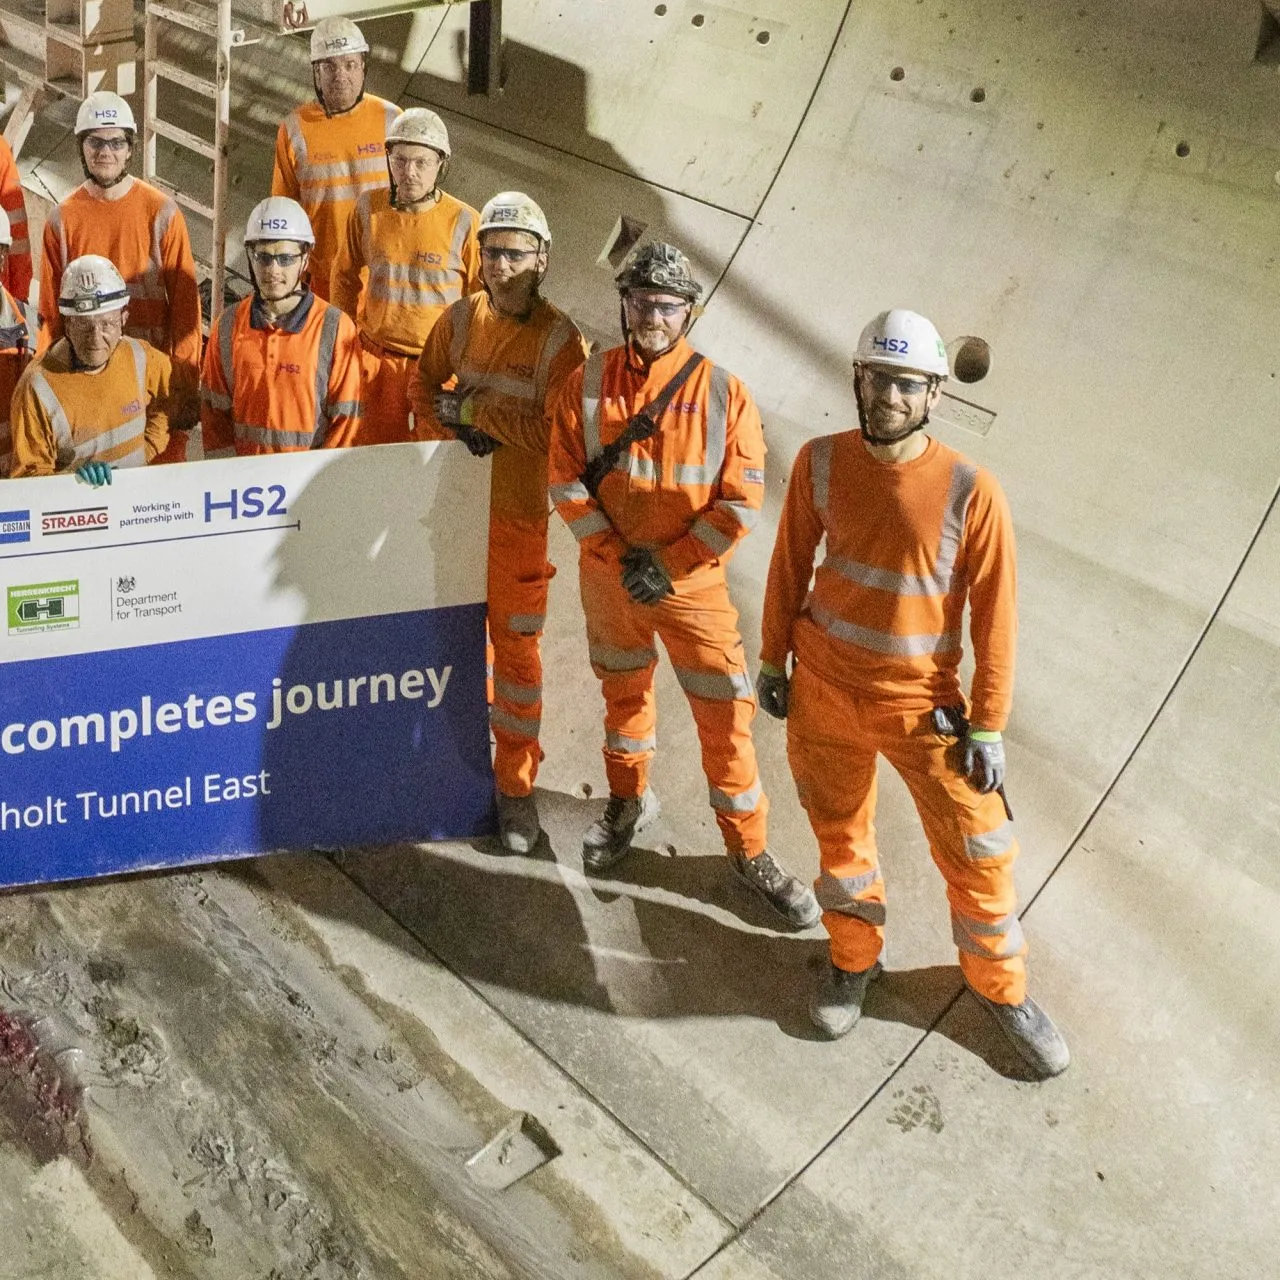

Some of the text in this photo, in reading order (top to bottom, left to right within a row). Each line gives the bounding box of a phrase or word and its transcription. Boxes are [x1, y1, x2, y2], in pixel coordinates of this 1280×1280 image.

[324, 37, 348, 50] HS2
[95, 109, 118, 119] HS2
[357, 143, 383, 154] HS2
[493, 208, 519, 218] HS2
[260, 219, 288, 230] HS2
[417, 251, 442, 265] HS2
[872, 336, 909, 354] HS2
[279, 363, 300, 374] HS2
[132, 500, 181, 515] Working in
[204, 484, 287, 523] HS2
[2, 521, 31, 533] COSTAIN
[41, 512, 109, 530] STRABAG
[120, 511, 194, 529] partnership with
[116, 591, 177, 608] Department
[116, 603, 182, 620] for Transport
[1, 691, 257, 754] completes
[267, 665, 452, 729] journey
[76, 777, 191, 820] Tunnel
[204, 769, 271, 803] East
